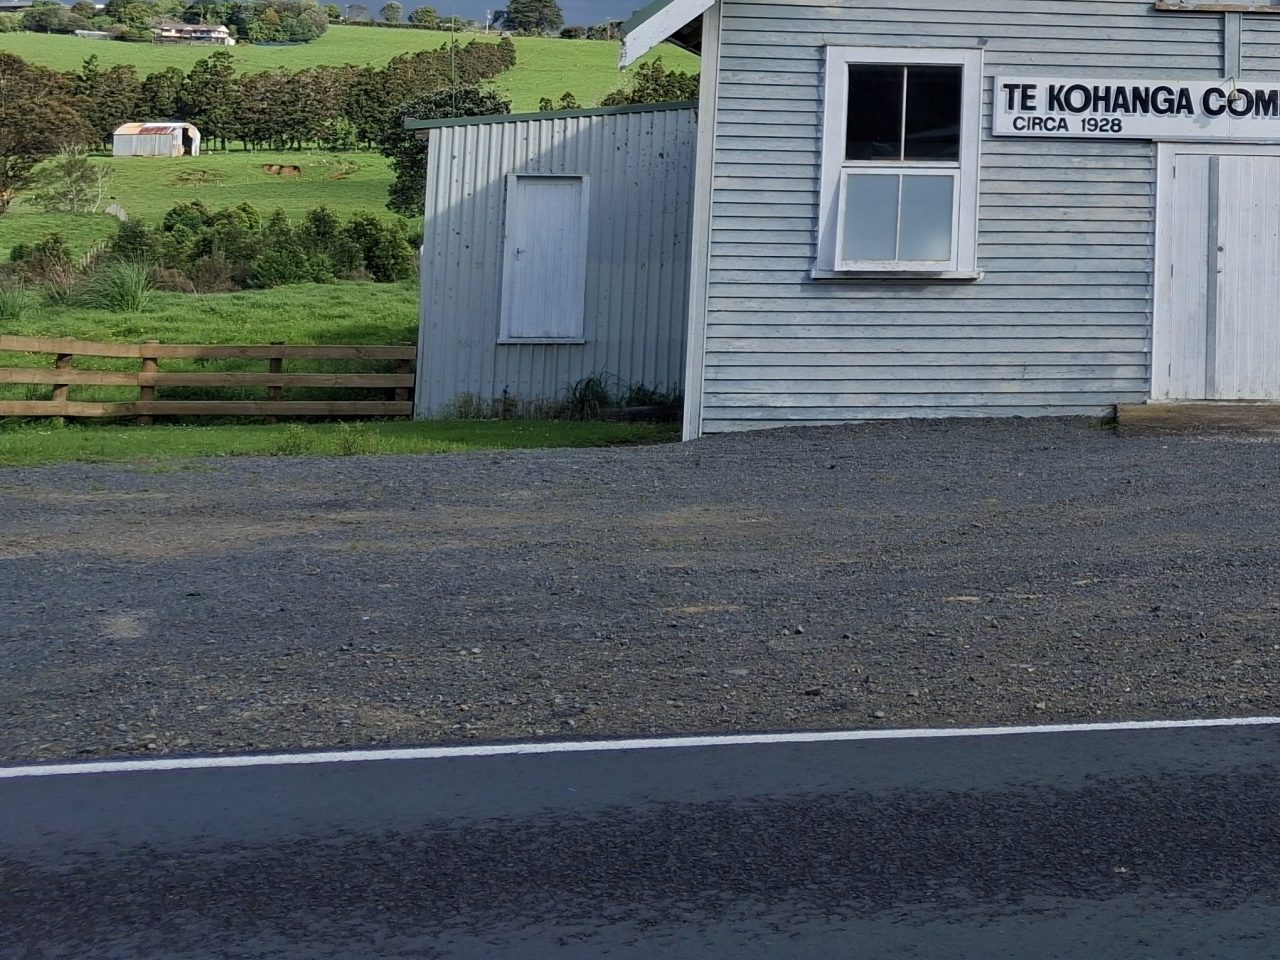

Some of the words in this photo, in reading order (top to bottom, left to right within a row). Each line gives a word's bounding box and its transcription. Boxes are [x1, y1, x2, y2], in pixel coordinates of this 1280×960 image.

[1003, 83, 1036, 111] TE
[1049, 83, 1194, 115] KOHANGA
[1012, 115, 1070, 132] CIRCA
[1081, 117, 1122, 133] 1928
